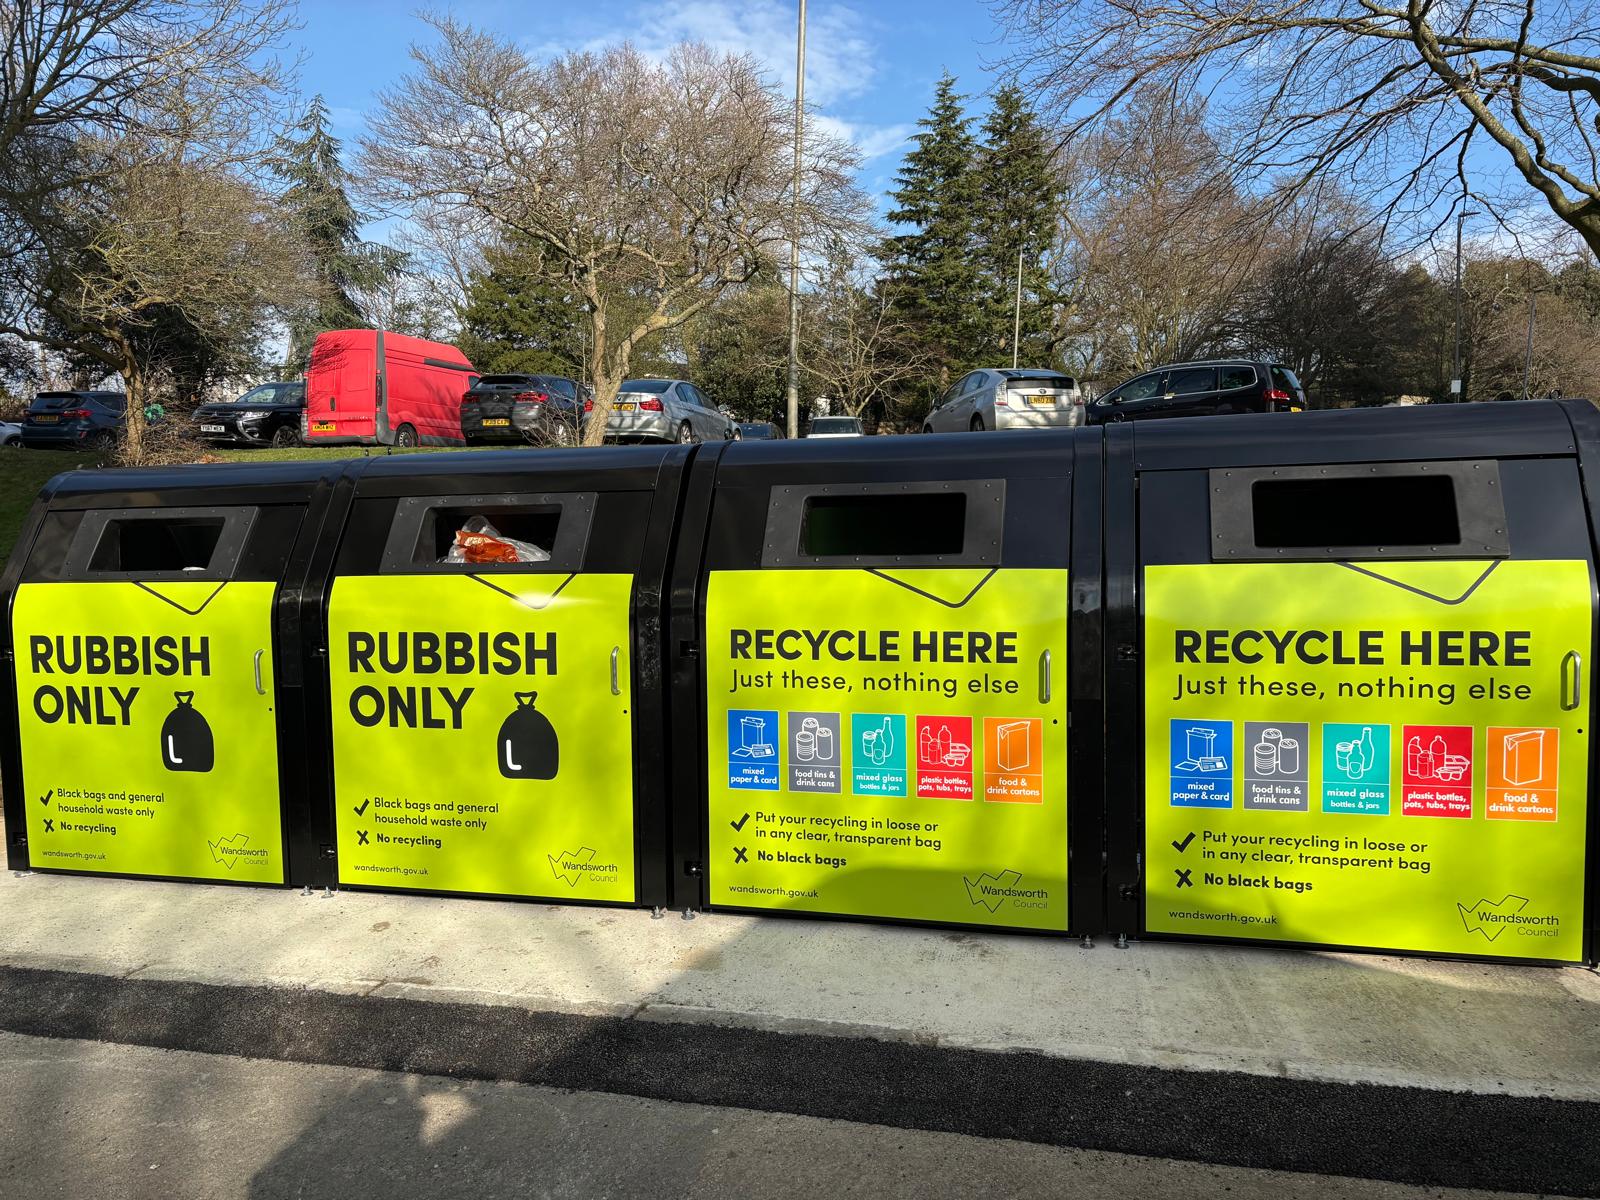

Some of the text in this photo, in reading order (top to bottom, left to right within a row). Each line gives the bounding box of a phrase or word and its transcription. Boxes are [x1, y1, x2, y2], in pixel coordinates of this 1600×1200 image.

[731, 629, 1018, 664] RECYCLE HERE
[1174, 629, 1531, 667] RECYCLE HERE
[30, 635, 210, 676] RUBBISH
[348, 631, 558, 675] RUBBISH
[730, 669, 1019, 698] Just these, nothing else
[1173, 674, 1531, 705] Just these, nothing else
[33, 684, 140, 725] ONLY
[349, 685, 475, 729] ONLY
[742, 767, 764, 775] mixed
[795, 770, 835, 779] food tins &
[731, 776, 777, 785] paper & card
[796, 778, 835, 788] drink cans
[856, 773, 902, 785] mixed glass
[921, 776, 968, 786] plastic bottles,
[999, 777, 1027, 786] food &
[860, 783, 881, 791] bottles
[889, 784, 900, 792] jars
[918, 784, 971, 795] pots, tubs, trays
[987, 786, 1039, 796] drink cartons
[1187, 782, 1214, 791] mixed
[1252, 784, 1301, 795] food tins &
[57, 789, 164, 804] Black bags and general
[1173, 792, 1229, 803] paper & card
[1253, 794, 1300, 805] drink cans
[1326, 788, 1384, 802] mixed glass
[1407, 791, 1466, 804] plastic bottles,
[1504, 793, 1538, 803] food &
[58, 803, 154, 818] household waste only
[374, 798, 499, 815] Black bags and general
[1330, 800, 1380, 810] bottles & jars
[1404, 801, 1470, 813] pots, tubs, trays
[1489, 803, 1553, 815] drink cartons
[375, 814, 487, 831] household waste only
[756, 812, 938, 831] Put your recycling in loose or
[60, 822, 116, 835] No recycling
[377, 833, 442, 848] No recycling
[756, 828, 941, 850] in any clear, transparent bag
[1203, 831, 1428, 853] Put your recycling in loose or
[42, 851, 106, 861] wandsworth.gov.uk
[220, 847, 268, 857] Wandsworth
[244, 858, 268, 866] Council
[758, 851, 847, 868] No black bags
[1203, 848, 1431, 873] in any clear, transparent bag
[354, 864, 428, 876] wandsworth.gov.uk
[562, 861, 618, 872] Wandsworth
[589, 873, 618, 882] Council
[1204, 873, 1313, 894] No black bags
[729, 885, 818, 899] wandsworth.gov.uk
[981, 885, 1048, 899] Wandsworth
[1014, 899, 1048, 909] Council
[1169, 910, 1278, 925] wandsworth.gov.uk
[1478, 911, 1559, 926] Wandsworth
[1517, 926, 1559, 938] Council
